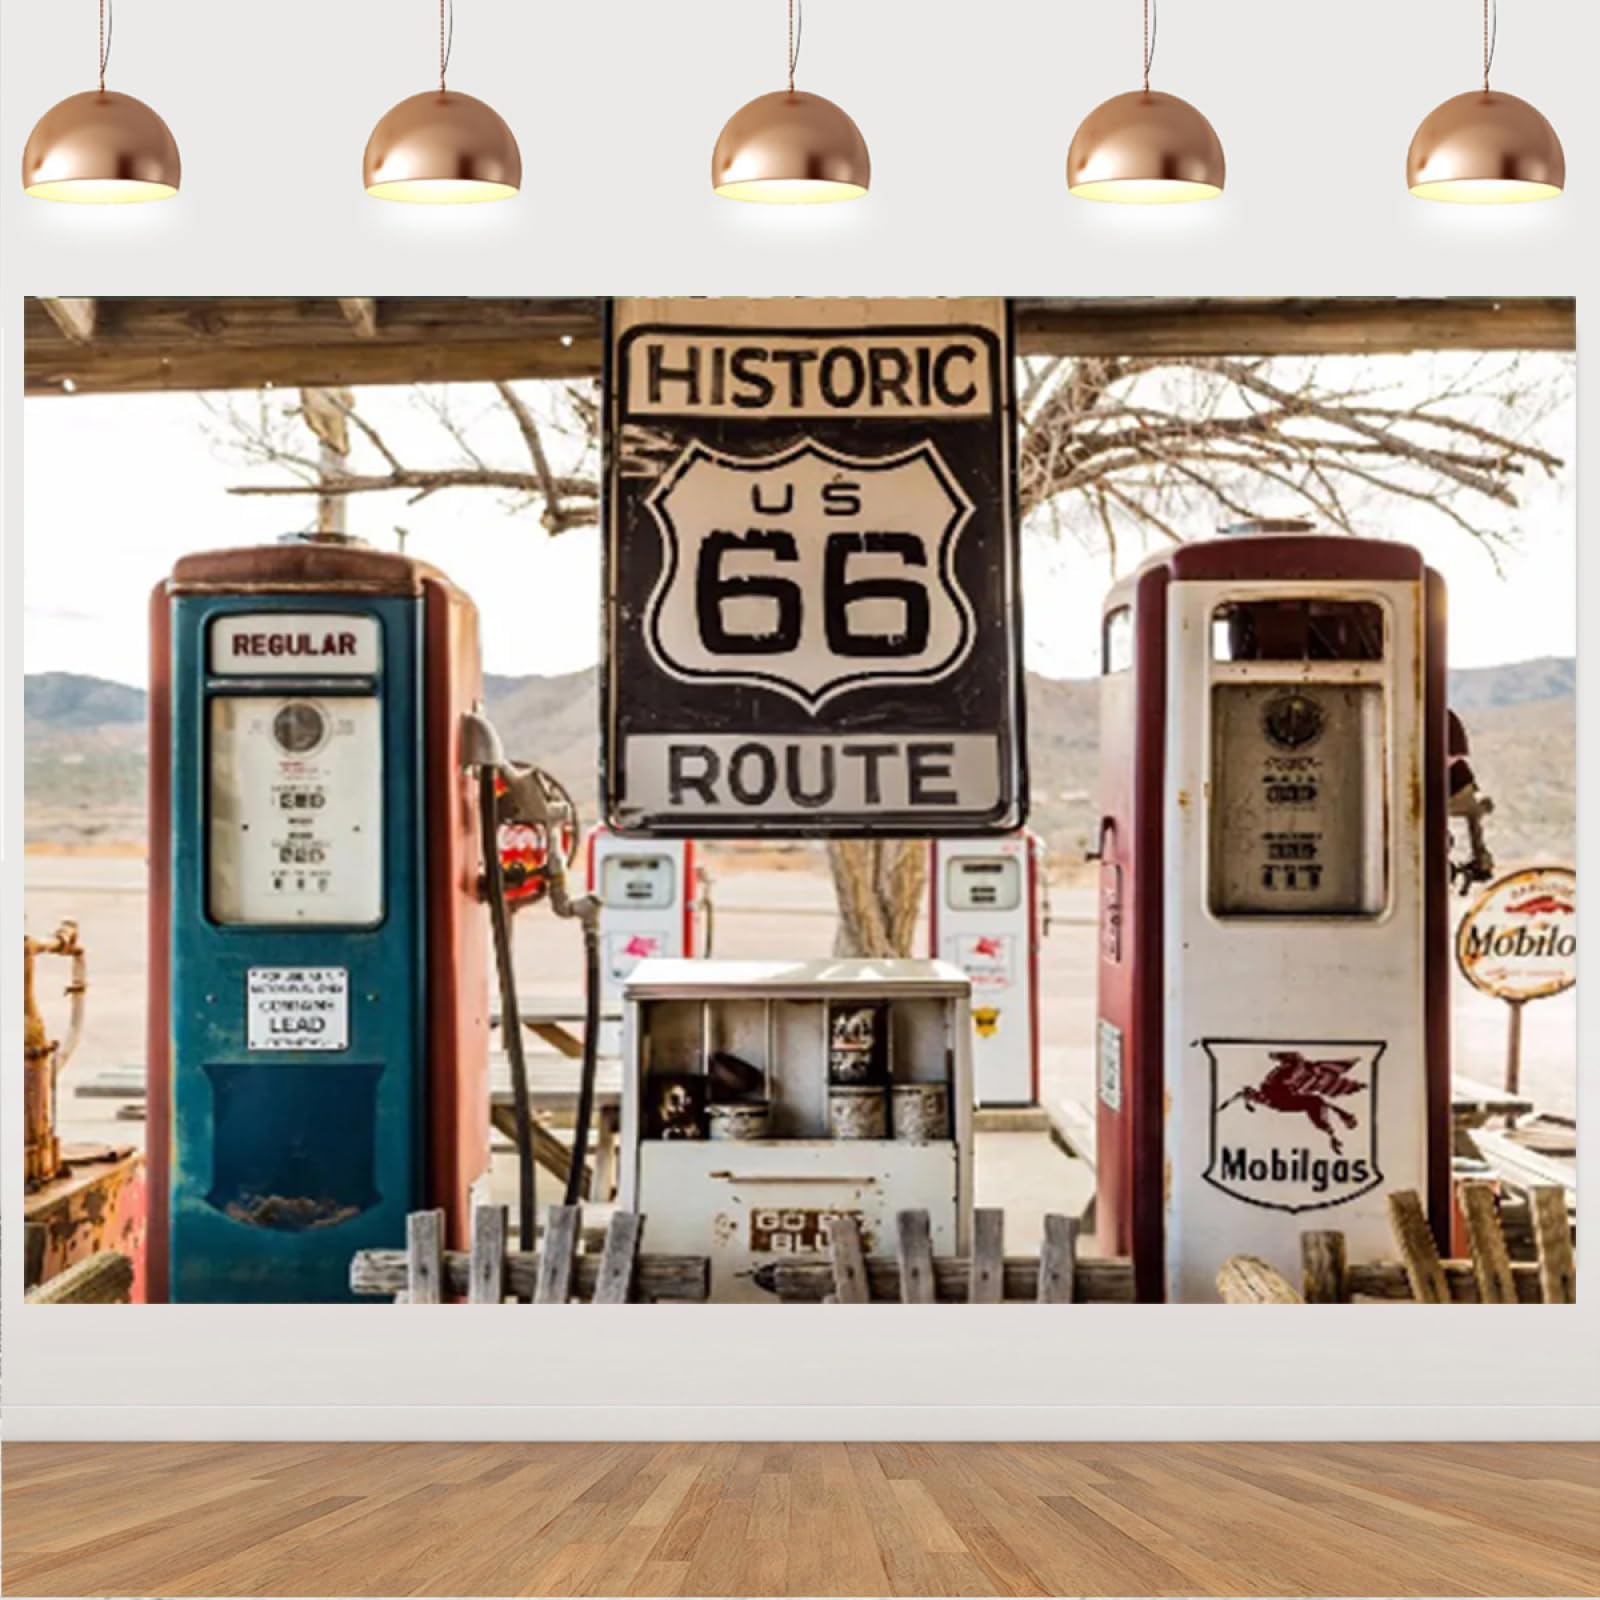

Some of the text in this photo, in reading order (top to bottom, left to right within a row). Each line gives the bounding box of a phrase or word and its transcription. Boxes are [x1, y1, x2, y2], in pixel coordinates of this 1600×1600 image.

[646, 343, 978, 409] HISTORIC
[696, 527, 931, 658] 66
[231, 632, 358, 656] REGULAR
[668, 742, 959, 808] ROUTE
[1466, 924, 1576, 957] Mobilo
[269, 1017, 326, 1034] LEAD
[1221, 1146, 1369, 1192] Mobilgas
[756, 1212, 806, 1232] GO
